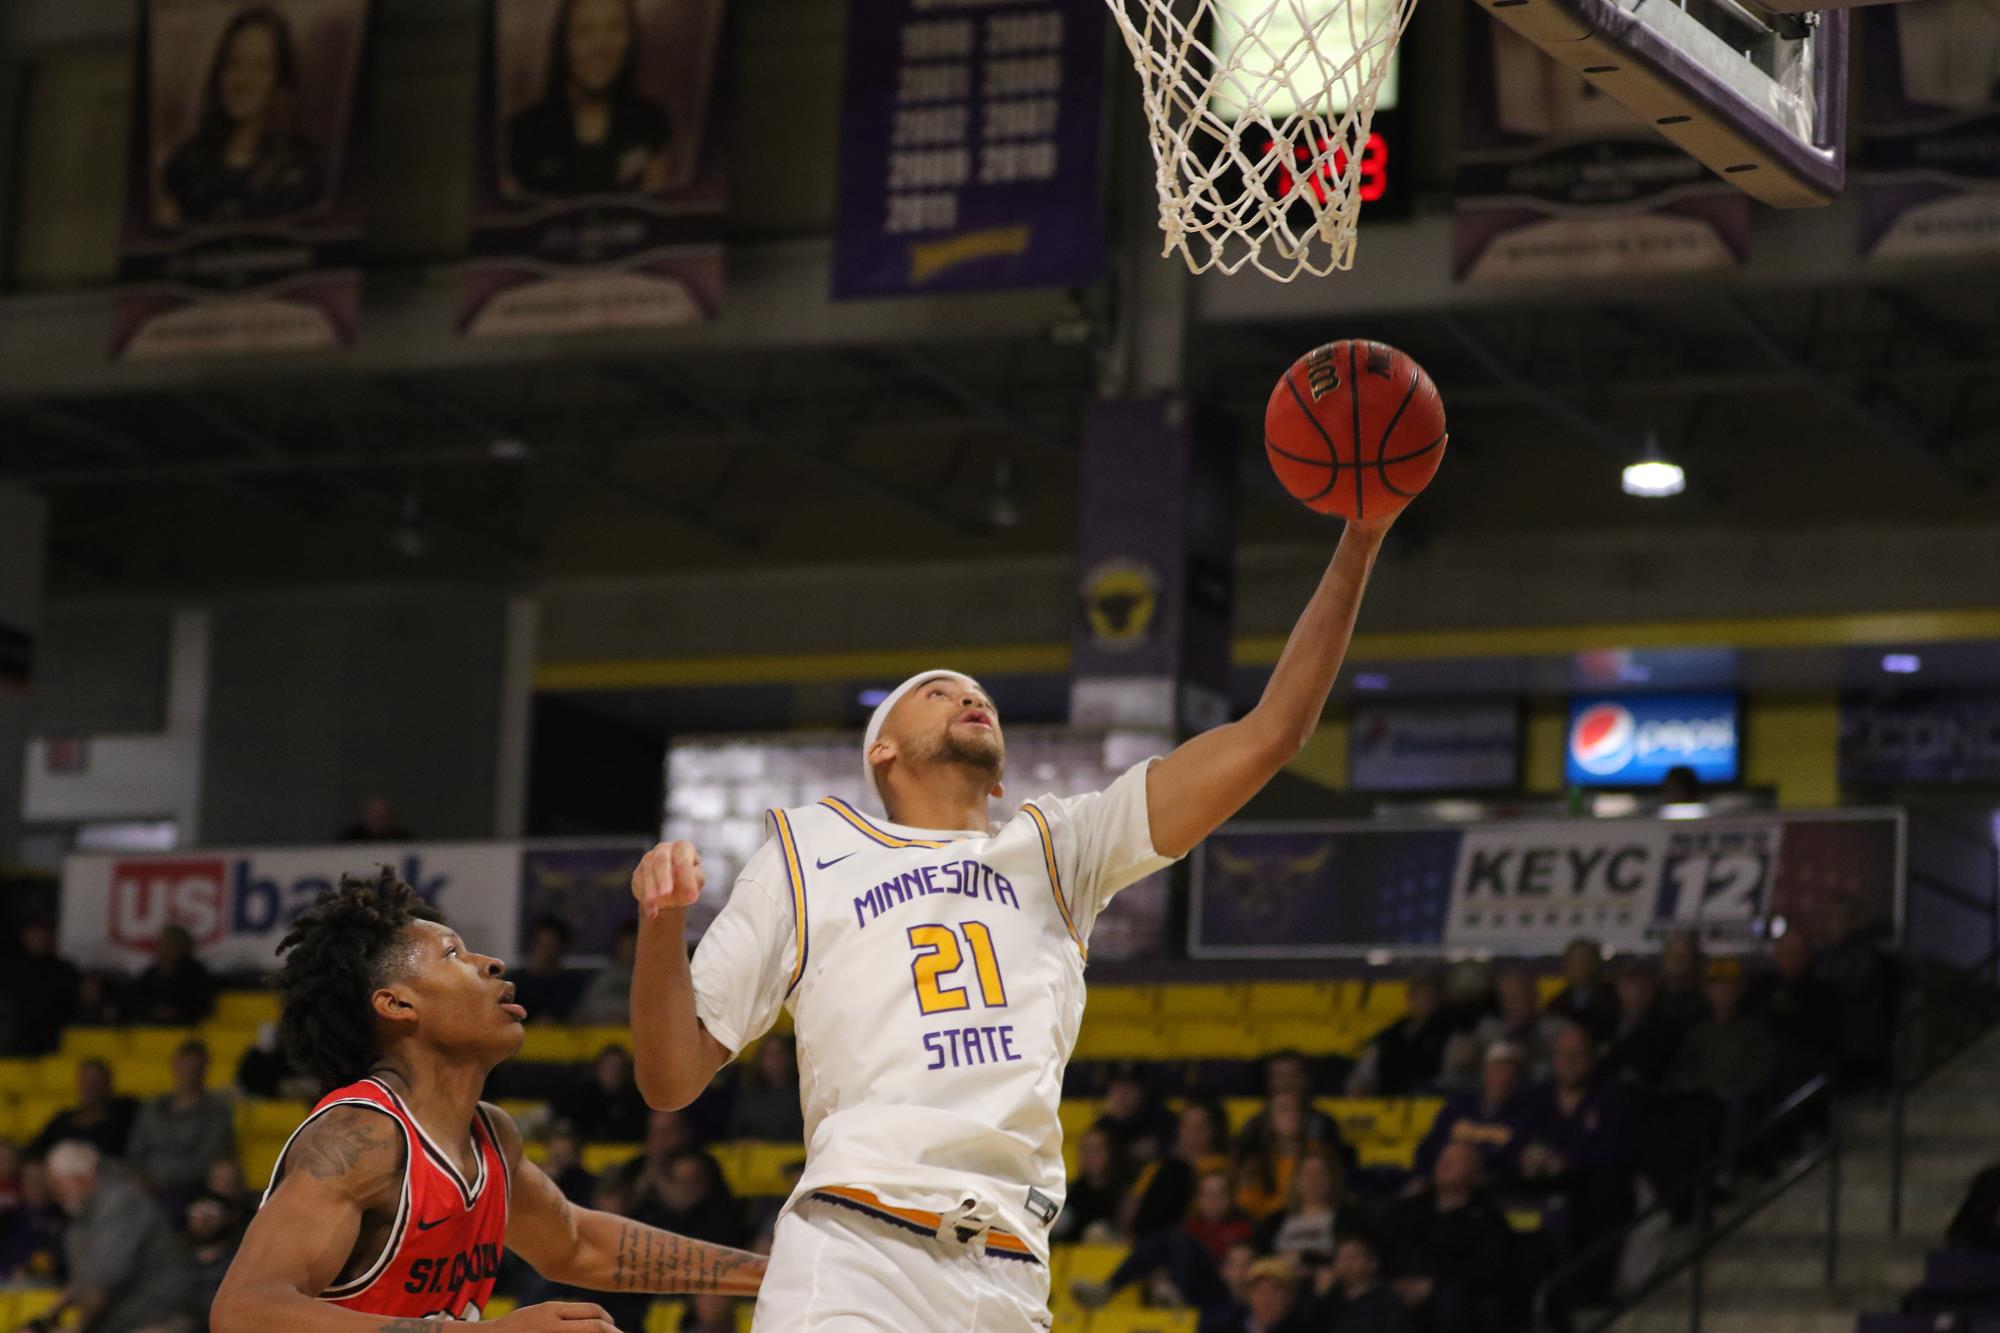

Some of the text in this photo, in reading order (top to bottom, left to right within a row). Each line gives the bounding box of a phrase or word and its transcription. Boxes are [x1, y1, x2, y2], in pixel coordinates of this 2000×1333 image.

[1637, 715, 1735, 757] pepsi
[852, 859, 1020, 929] MINNESOTA
[1465, 846, 1650, 895] KEYC
[1671, 854, 1764, 919] 12
[906, 920, 1008, 1016] 21
[922, 1025, 1022, 1071] STATE
